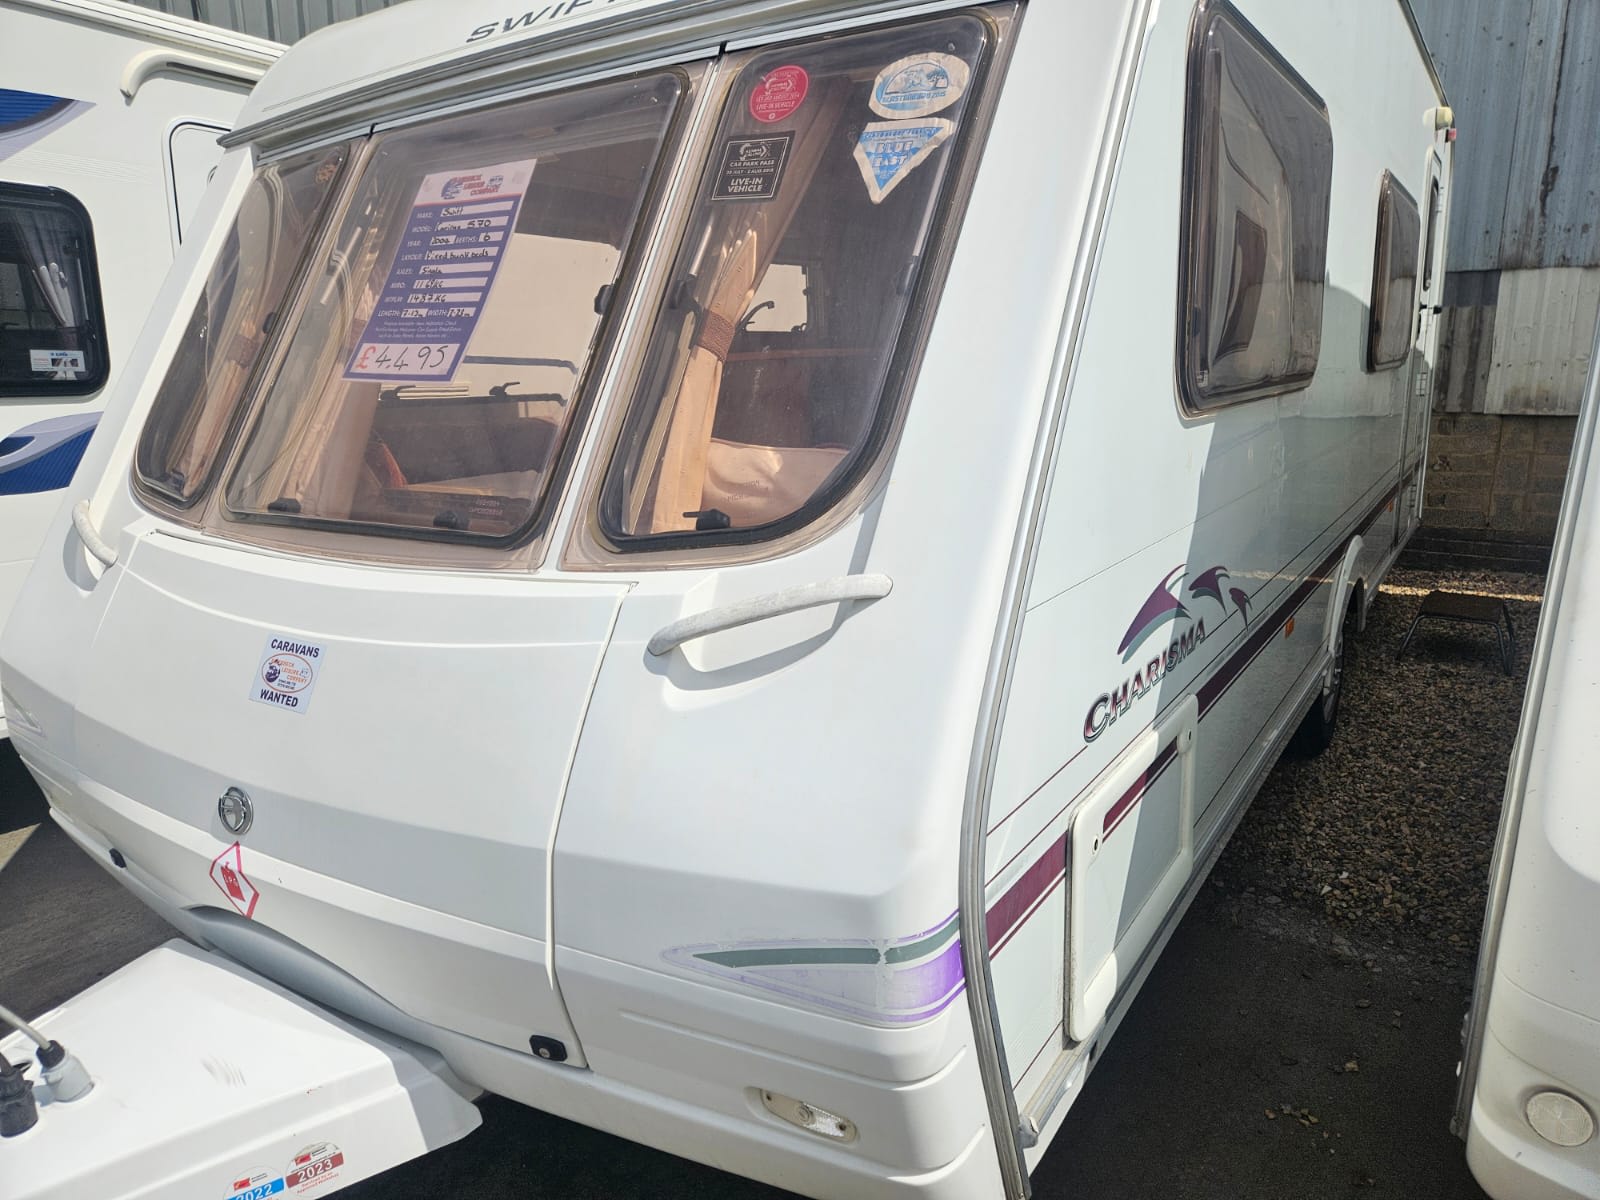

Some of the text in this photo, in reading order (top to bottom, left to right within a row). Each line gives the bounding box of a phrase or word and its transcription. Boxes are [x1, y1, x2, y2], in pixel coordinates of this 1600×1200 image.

[876, 141, 913, 154] BLUE
[759, 159, 775, 167] PASS
[871, 154, 907, 167] EAST
[731, 177, 763, 186] LIVE-IN
[727, 184, 763, 193] VEHICLE
[270, 638, 320, 658] CARAVANS
[1083, 616, 1206, 743] CHARISMA
[260, 688, 299, 708] WANTED
[297, 1159, 333, 1183] 2023
